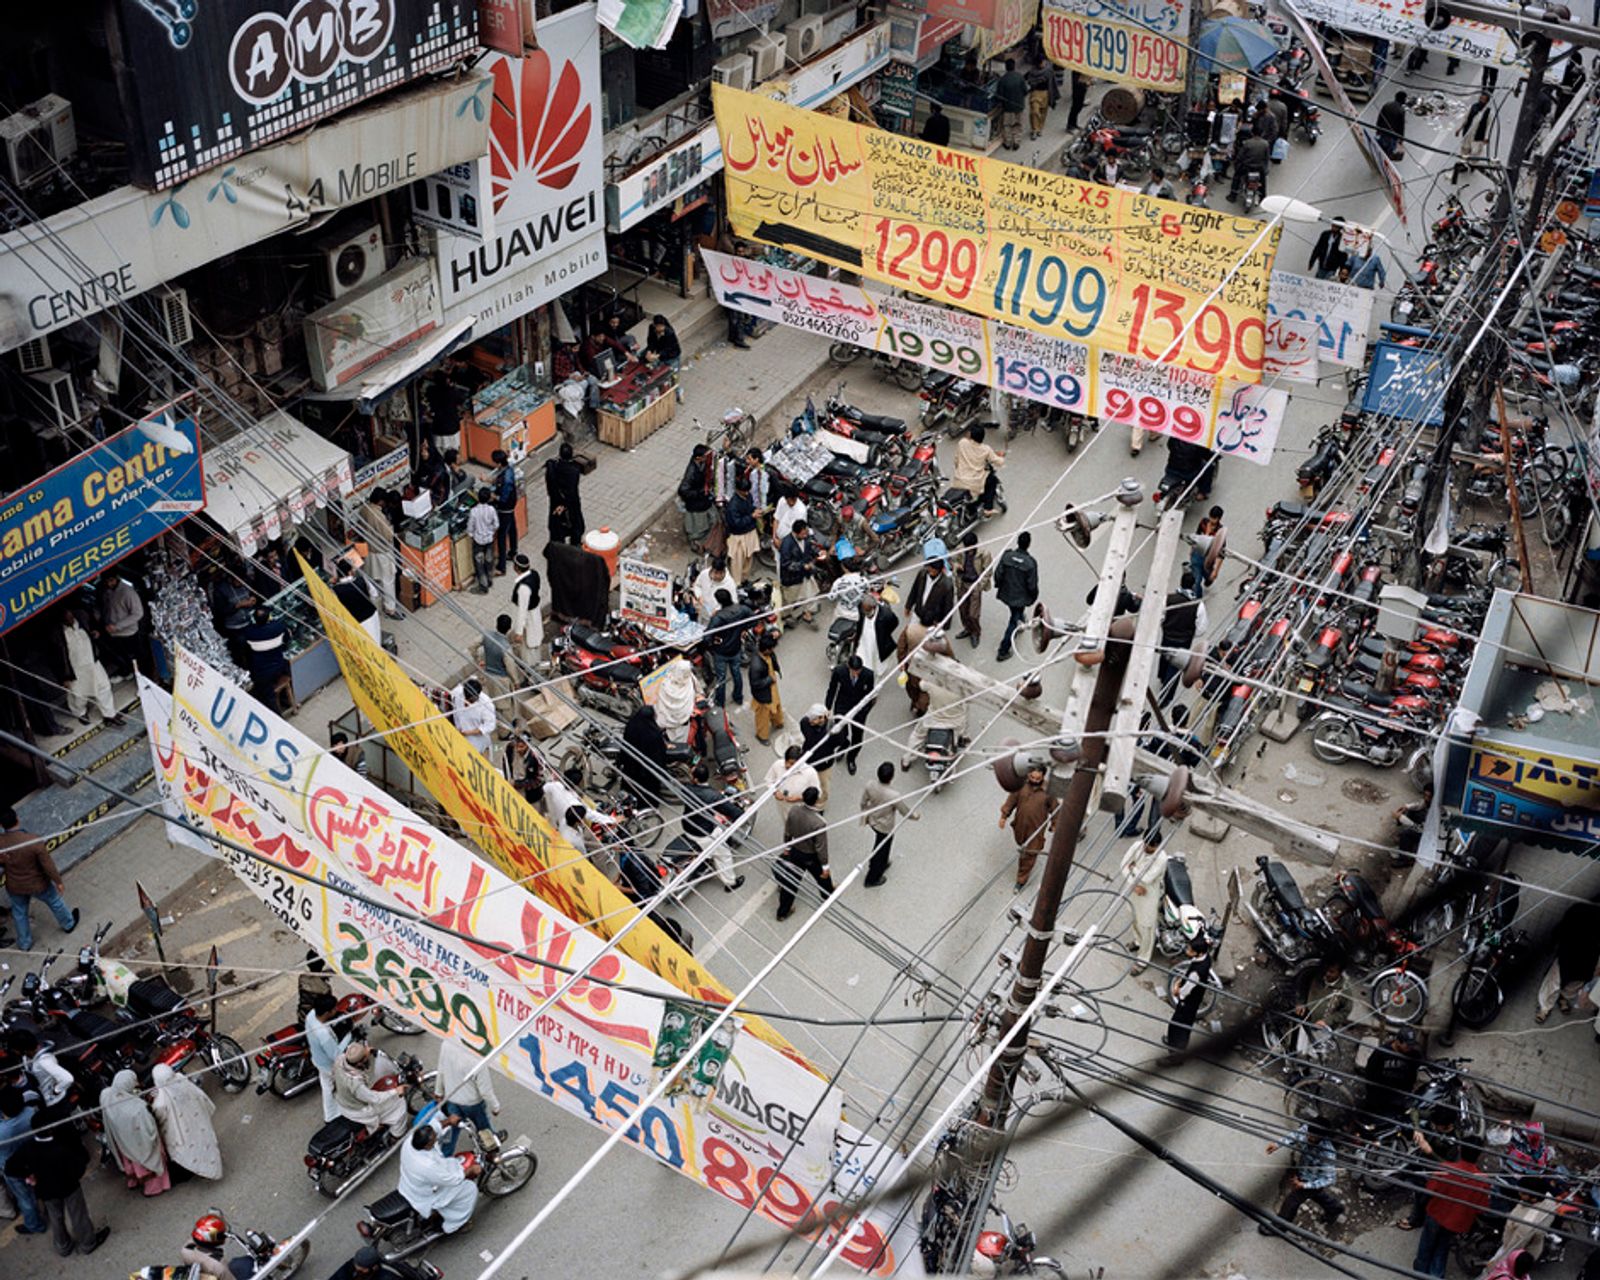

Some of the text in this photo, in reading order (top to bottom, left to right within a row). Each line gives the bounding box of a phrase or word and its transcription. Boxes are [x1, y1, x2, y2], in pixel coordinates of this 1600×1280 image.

[245, 0, 380, 92] AMB
[1048, 15, 1085, 65] 1199
[1085, 23, 1129, 74] 1399
[1131, 33, 1179, 84] 1599
[1463, 39, 1493, 59] Days
[936, 149, 977, 173] MTK
[1020, 171, 1039, 187] FM
[1078, 186, 1111, 209] X5
[28, 264, 137, 331] CENTRE
[338, 151, 417, 203] MOBILE
[450, 190, 596, 293] HUAWEI
[544, 250, 600, 288] Mobile
[874, 216, 978, 300] 1299
[992, 241, 1108, 337] 1199
[884, 325, 982, 375] 1999
[995, 355, 1082, 406] 1599
[1104, 387, 1203, 438] 999
[0, 497, 74, 562] ama
[28, 489, 45, 505] to
[50, 510, 106, 548] Phone
[111, 466, 175, 511] Market
[10, 525, 132, 614] UNIVERSE
[436, 942, 461, 971] FACE
[338, 922, 495, 1058] 2699
[518, 1031, 685, 1168] 1450
